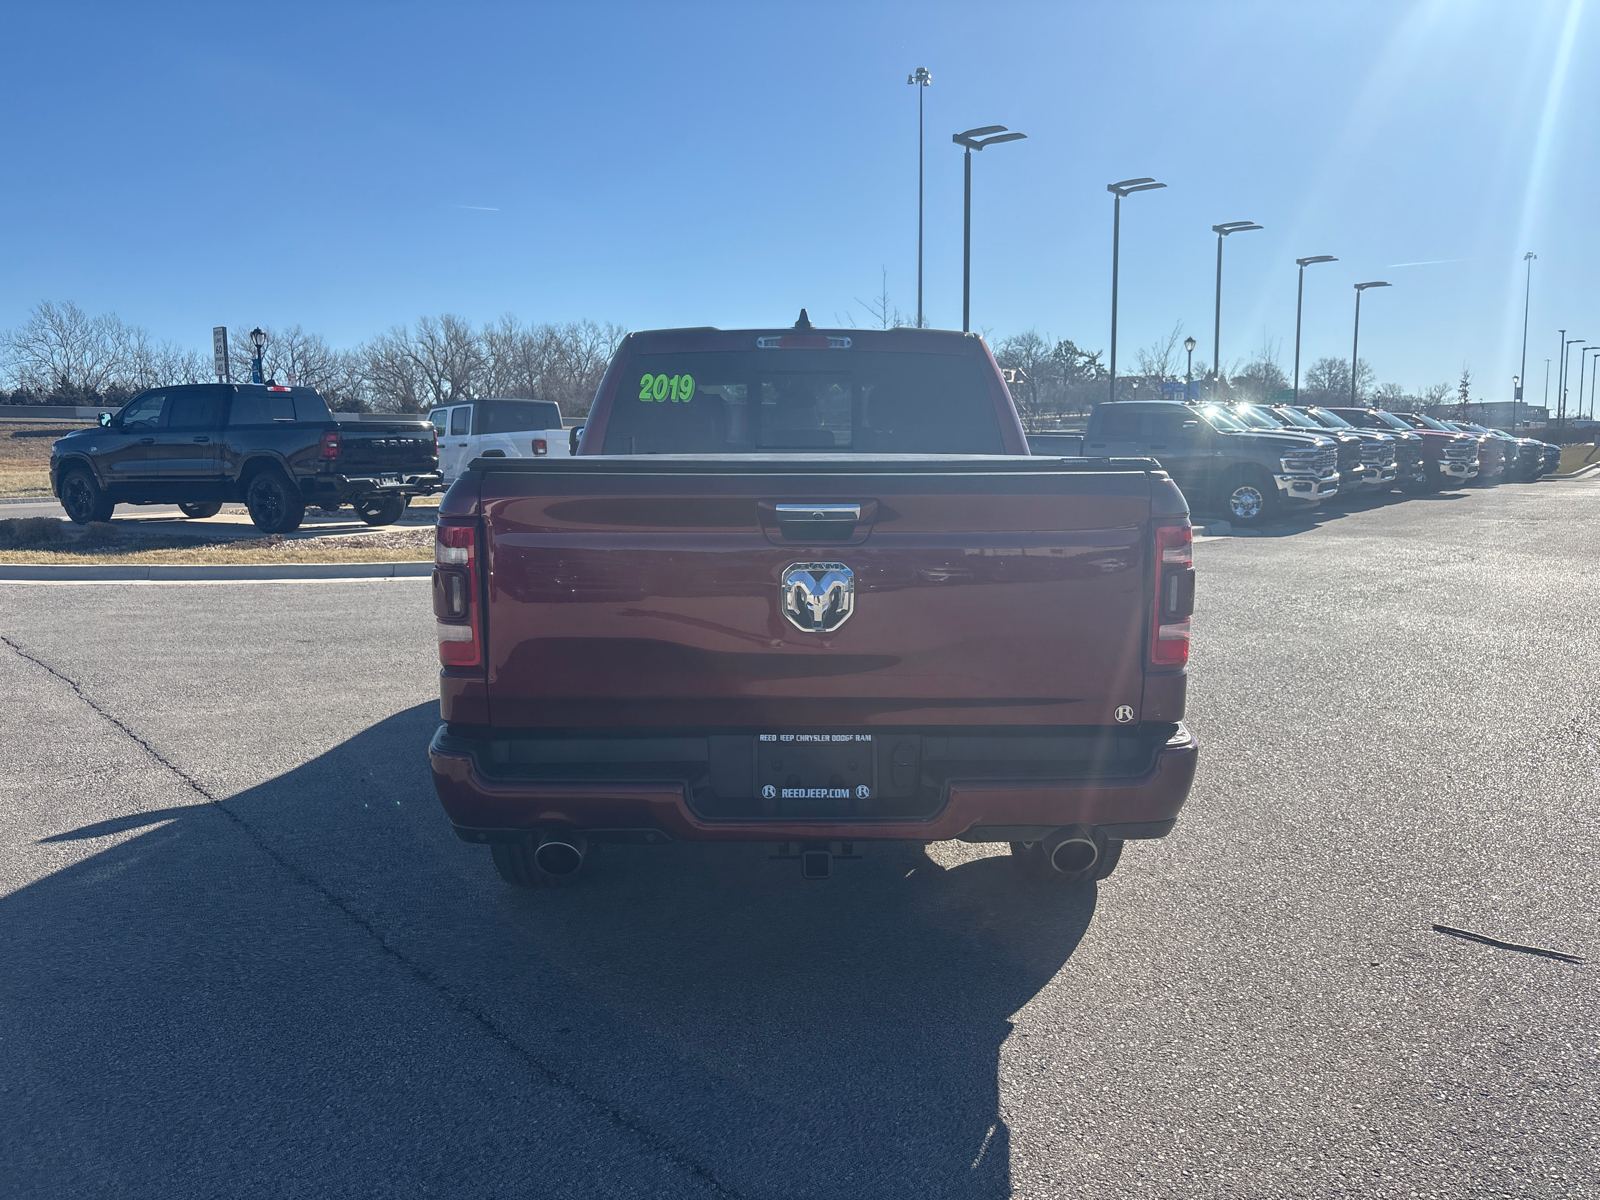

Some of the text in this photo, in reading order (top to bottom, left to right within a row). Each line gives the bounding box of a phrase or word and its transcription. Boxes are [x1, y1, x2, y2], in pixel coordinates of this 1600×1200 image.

[216, 345, 222, 355] 60
[217, 363, 224, 371] 40
[639, 373, 696, 403] 2019
[781, 788, 850, 799] REEDJEEP.COM
